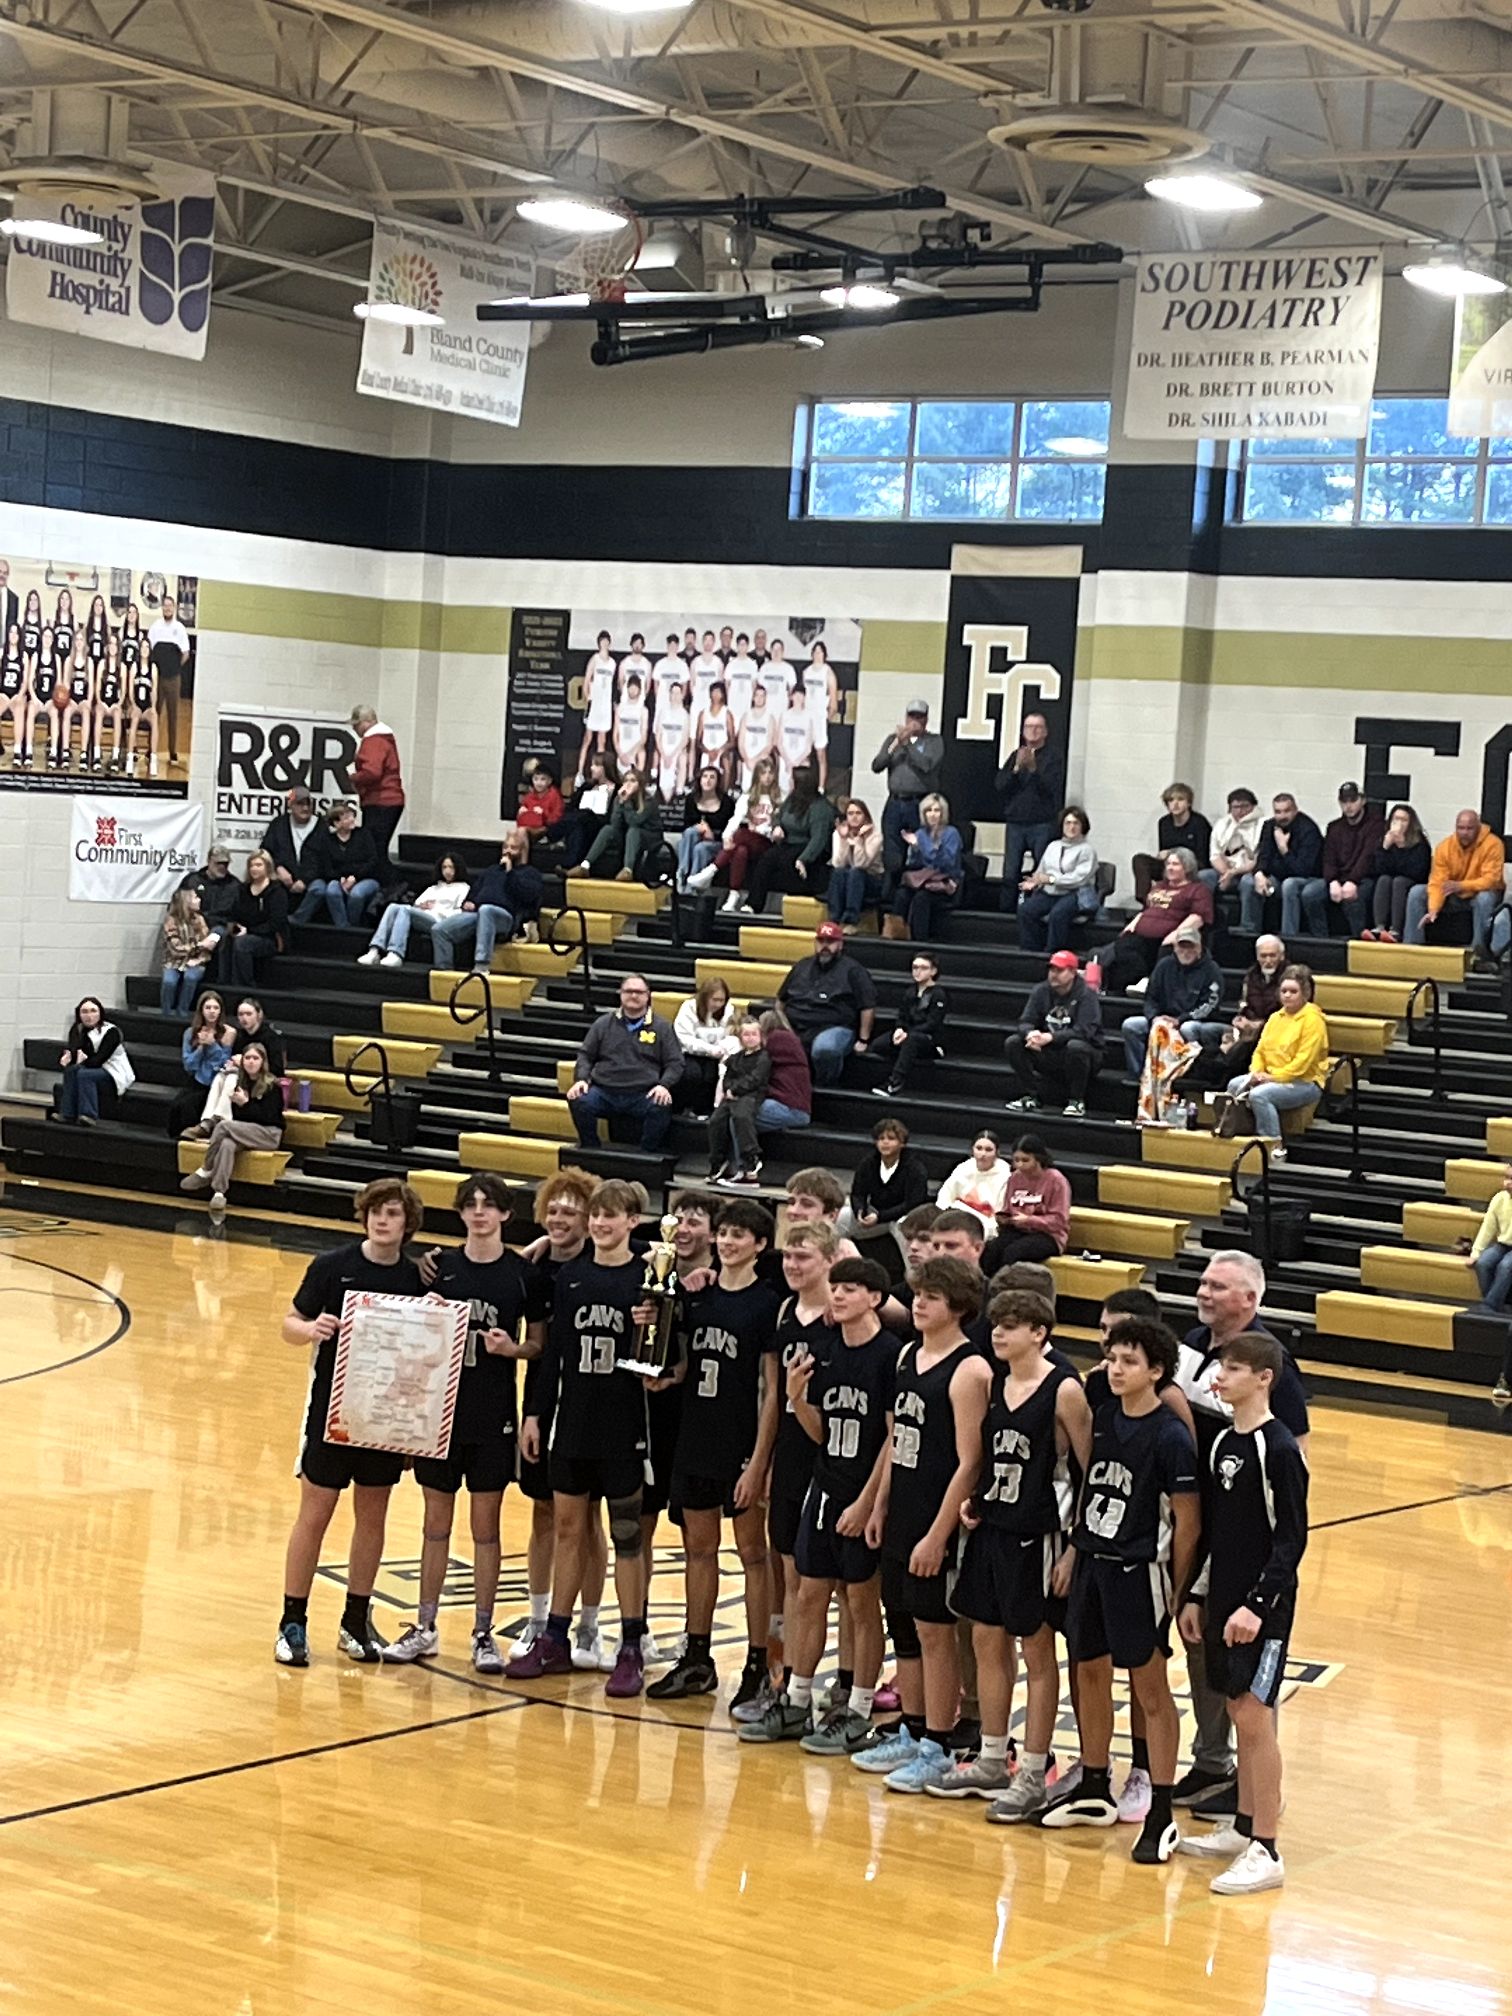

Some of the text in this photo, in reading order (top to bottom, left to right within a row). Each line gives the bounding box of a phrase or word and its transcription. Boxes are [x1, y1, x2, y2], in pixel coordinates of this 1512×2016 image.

[61, 203, 132, 253] County
[13, 236, 132, 288] Community
[1140, 255, 1378, 293] SOUTHWEST
[48, 270, 131, 315] Hospital
[1161, 295, 1351, 331] PODIATRY
[430, 326, 525, 369] Bland County
[430, 346, 511, 379] Medical Clinic
[1137, 352, 1166, 368] DR.
[1171, 351, 1255, 368] HEATHER
[1280, 349, 1369, 366] PEARMAN
[1166, 380, 1335, 398] DR. BRETT BURTON
[1168, 412, 1196, 428] DR.
[1257, 411, 1328, 427] KABADI
[218, 719, 358, 795] R&R
[118, 828, 143, 847] First
[75, 839, 198, 873] Community Bank
[466, 1298, 499, 1328] AVS
[574, 1304, 624, 1333] CAVS
[579, 1335, 615, 1374] 13
[692, 1326, 738, 1359] CAVS
[698, 1358, 719, 1397] 3
[823, 1385, 868, 1415] CAVS
[894, 1391, 926, 1425] CAVS
[827, 1417, 860, 1458] 10
[993, 1429, 1031, 1460] CAVS
[1088, 1461, 1133, 1496] CAVS
